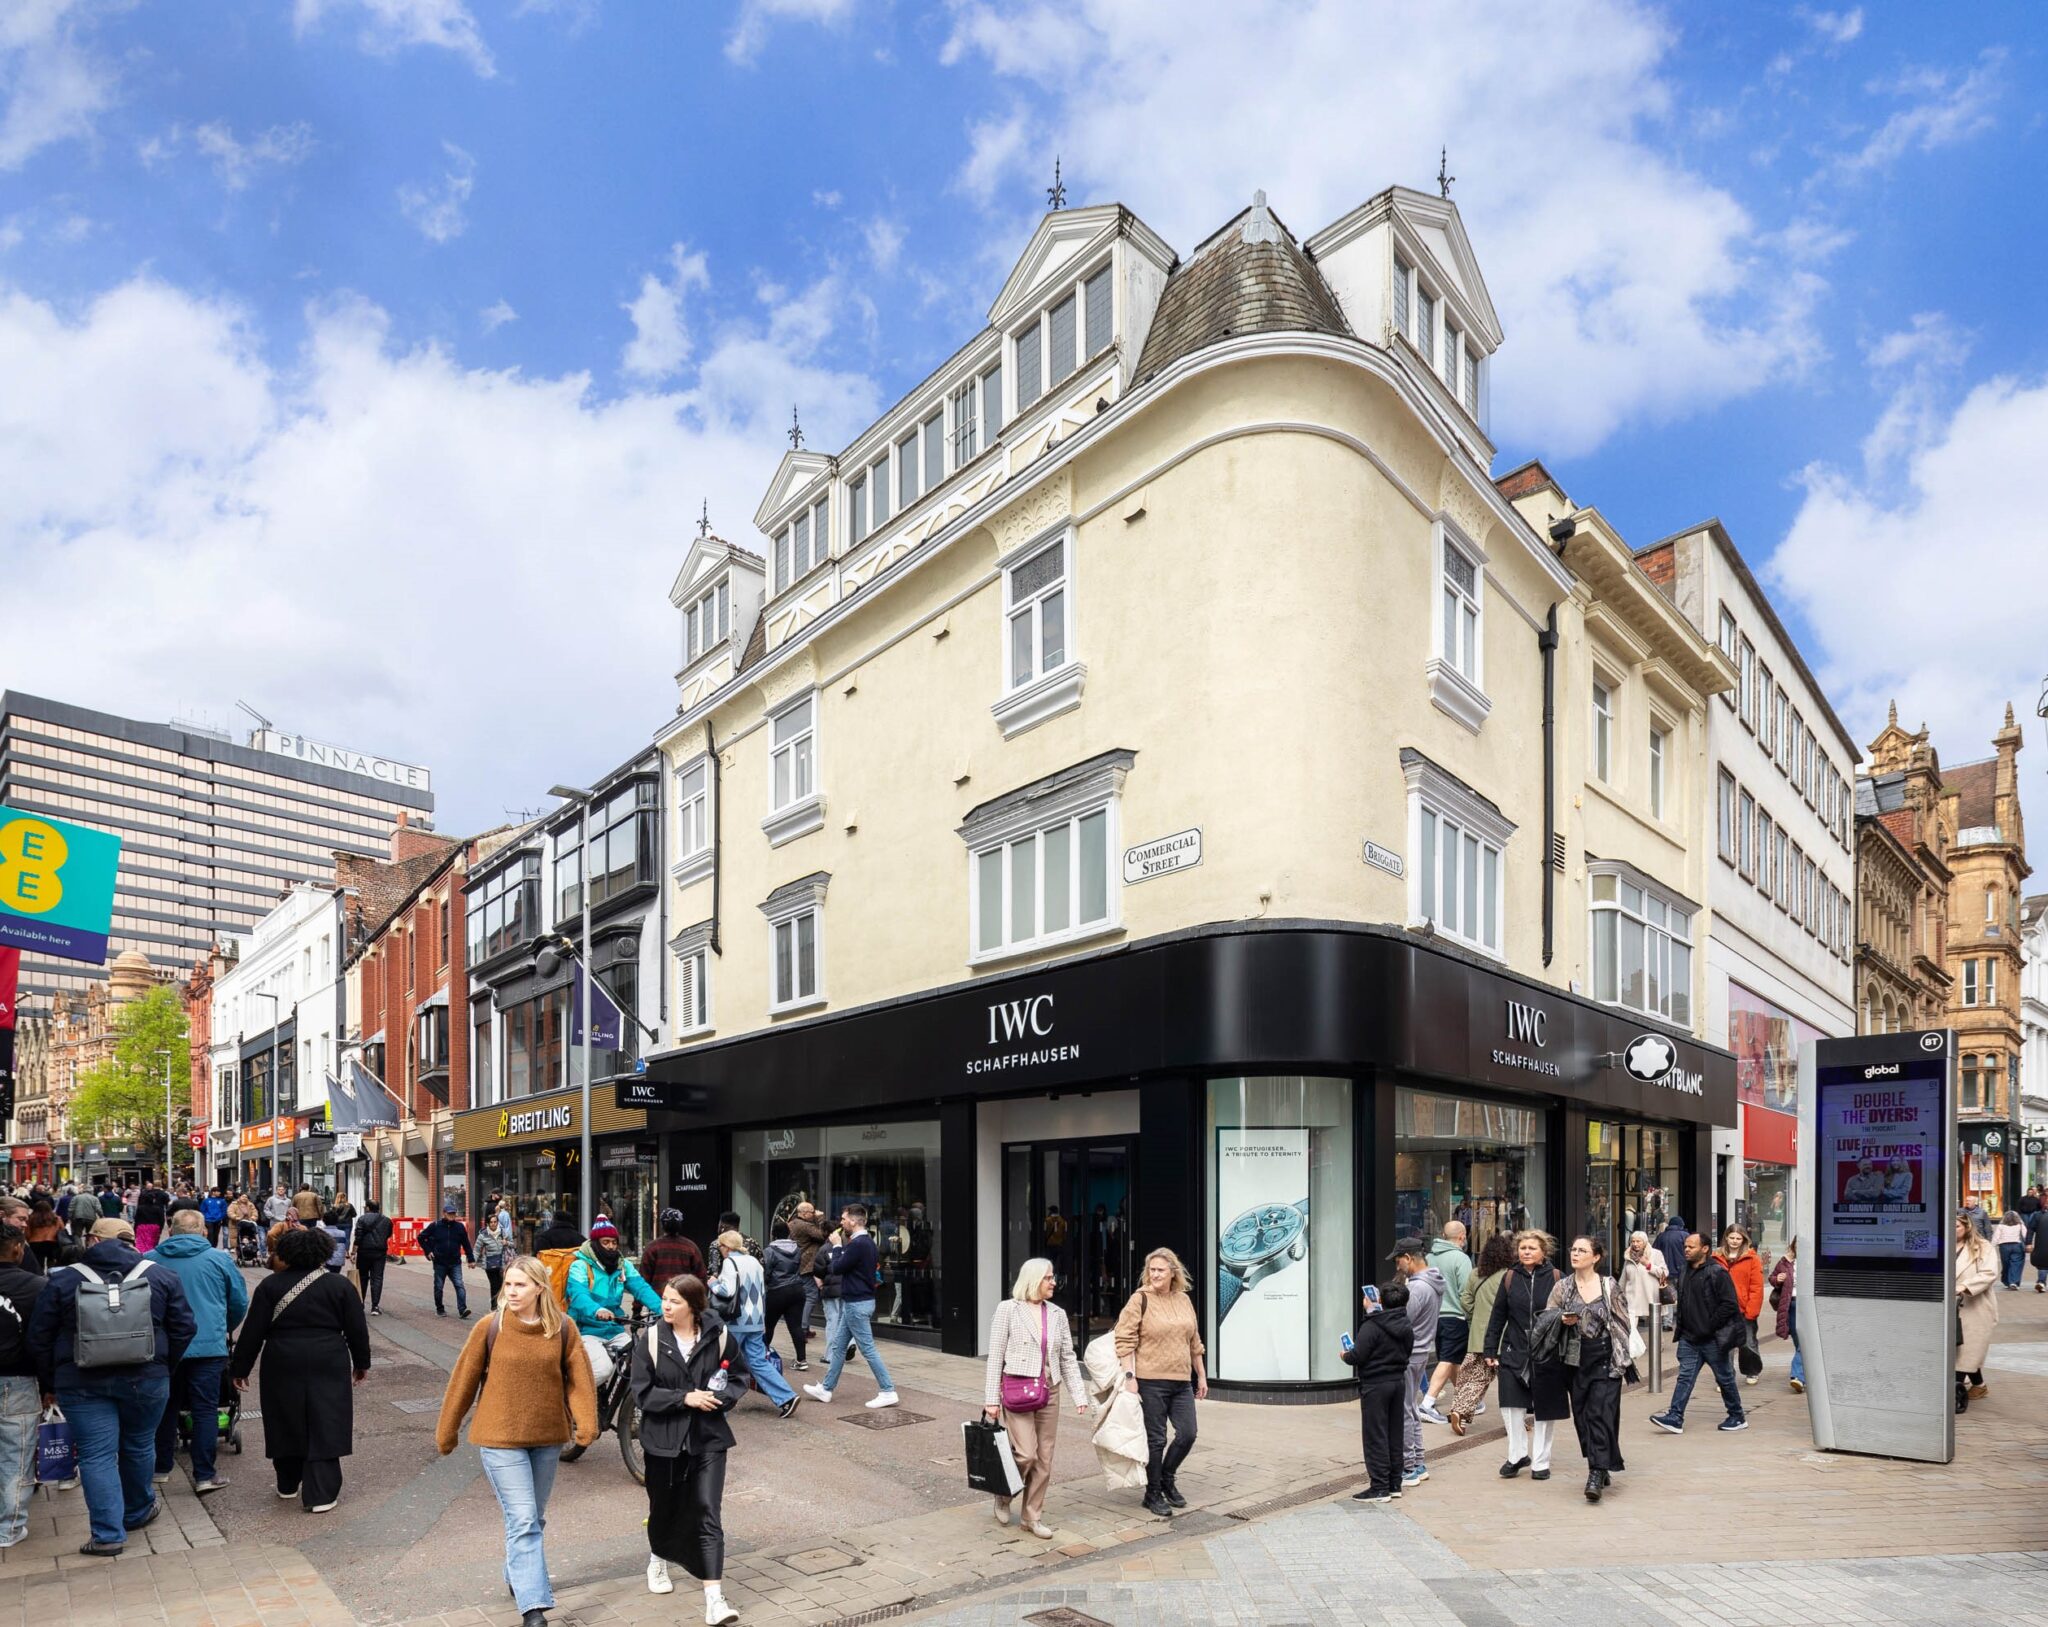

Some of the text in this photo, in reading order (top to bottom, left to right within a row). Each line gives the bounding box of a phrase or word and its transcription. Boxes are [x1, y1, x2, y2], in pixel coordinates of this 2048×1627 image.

[280, 735, 417, 786] PINNACLE
[1128, 836, 1196, 864] COMMERCIAL
[1142, 855, 1181, 875] STREET
[1, 925, 71, 946] Available here
[988, 993, 1054, 1044] IWC
[1507, 1000, 1547, 1048] IWC
[577, 1029, 614, 1039] BITLING
[1925, 1037, 1939, 1046] BT
[966, 1045, 1080, 1074] SCHAFFHAUSEN
[1493, 1049, 1560, 1077] SCHAFFHAUSEN
[1864, 1063, 1899, 1079] global
[1653, 1067, 1703, 1096] NTBLANC
[632, 1086, 655, 1097] IWC
[1854, 1091, 1906, 1108] DOUBLE
[510, 1105, 571, 1134] BREITLING
[1841, 1107, 1918, 1125] THE DYERS!
[1836, 1138, 1860, 1152] LIVE
[1862, 1144, 1922, 1158] LET DYERS
[682, 1162, 701, 1180] IWC
[44, 1445, 69, 1456] M&S
